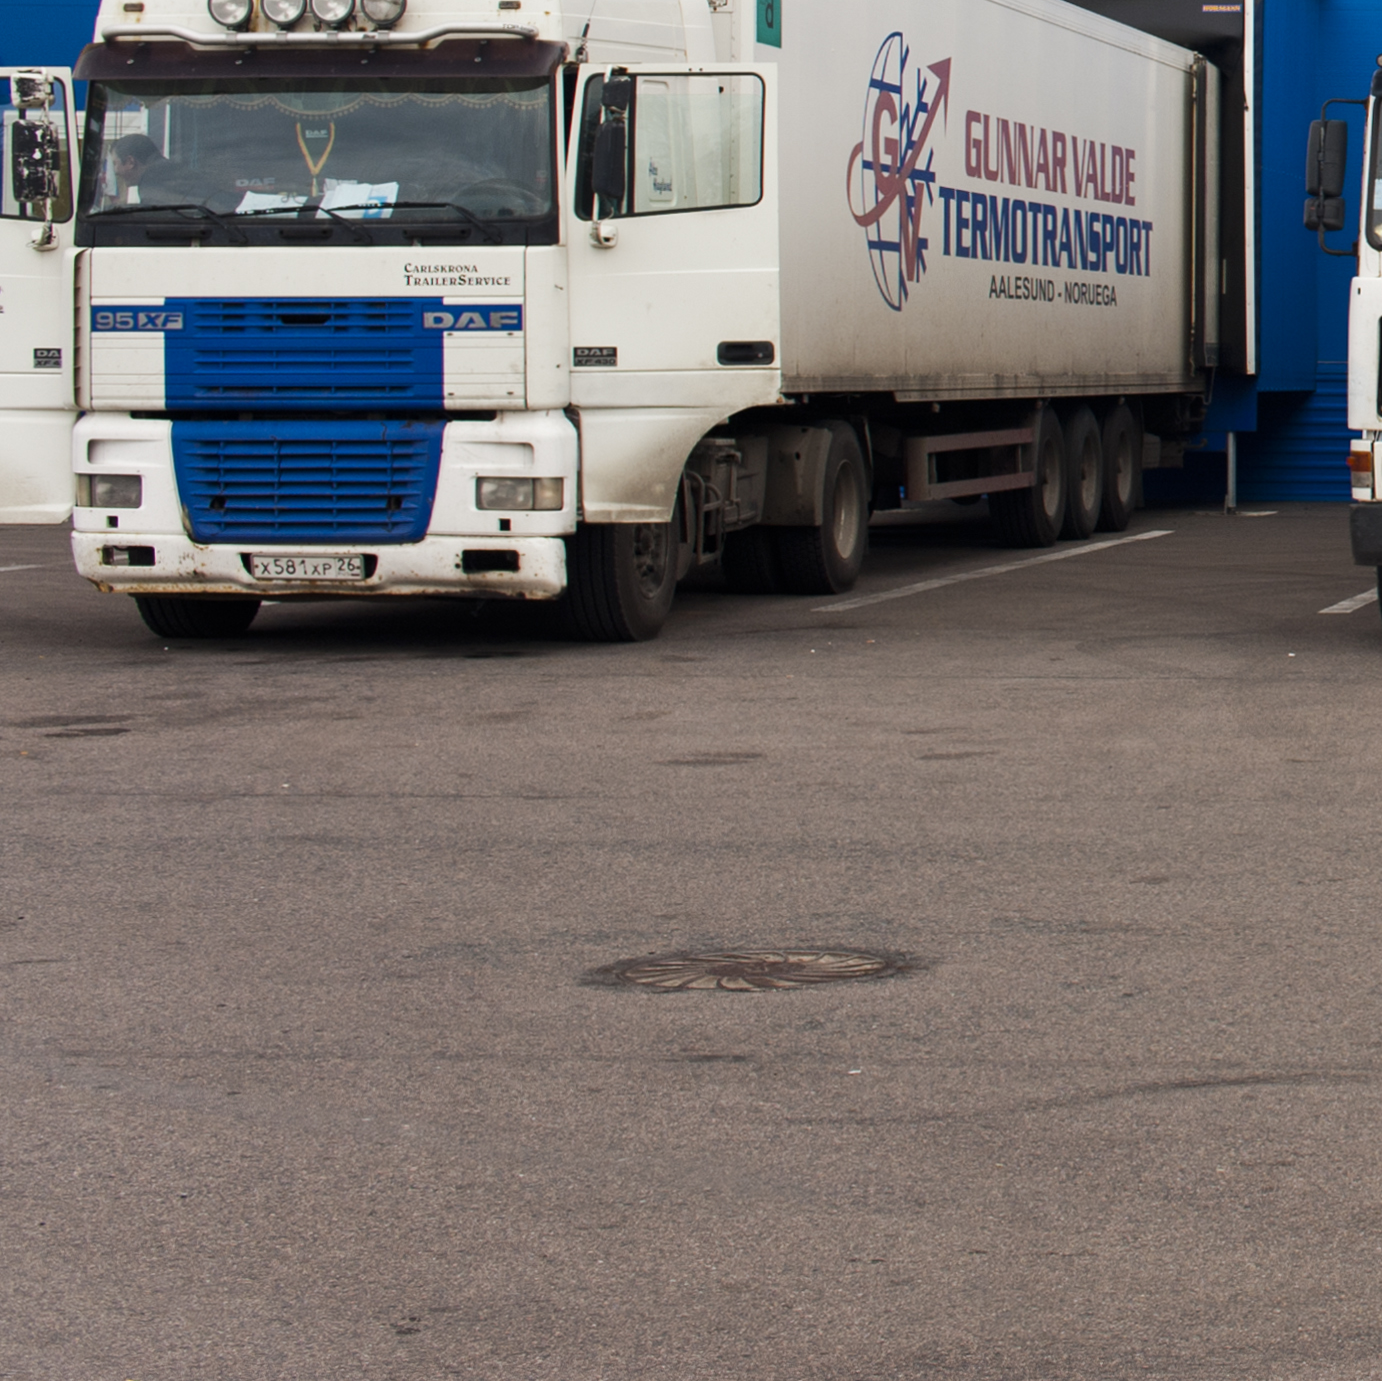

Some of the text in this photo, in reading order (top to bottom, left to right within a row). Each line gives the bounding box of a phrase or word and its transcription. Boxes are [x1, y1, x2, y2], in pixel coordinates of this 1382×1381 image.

[965, 109, 1136, 207] GUNNAR VALDE
[938, 186, 1153, 277] TERMOTRANSPORT
[989, 274, 1055, 302] AALESUND
[1064, 281, 1117, 307] NORUEGA
[95, 311, 134, 330] 95
[423, 311, 518, 329] DAF
[576, 348, 614, 356] DAF
